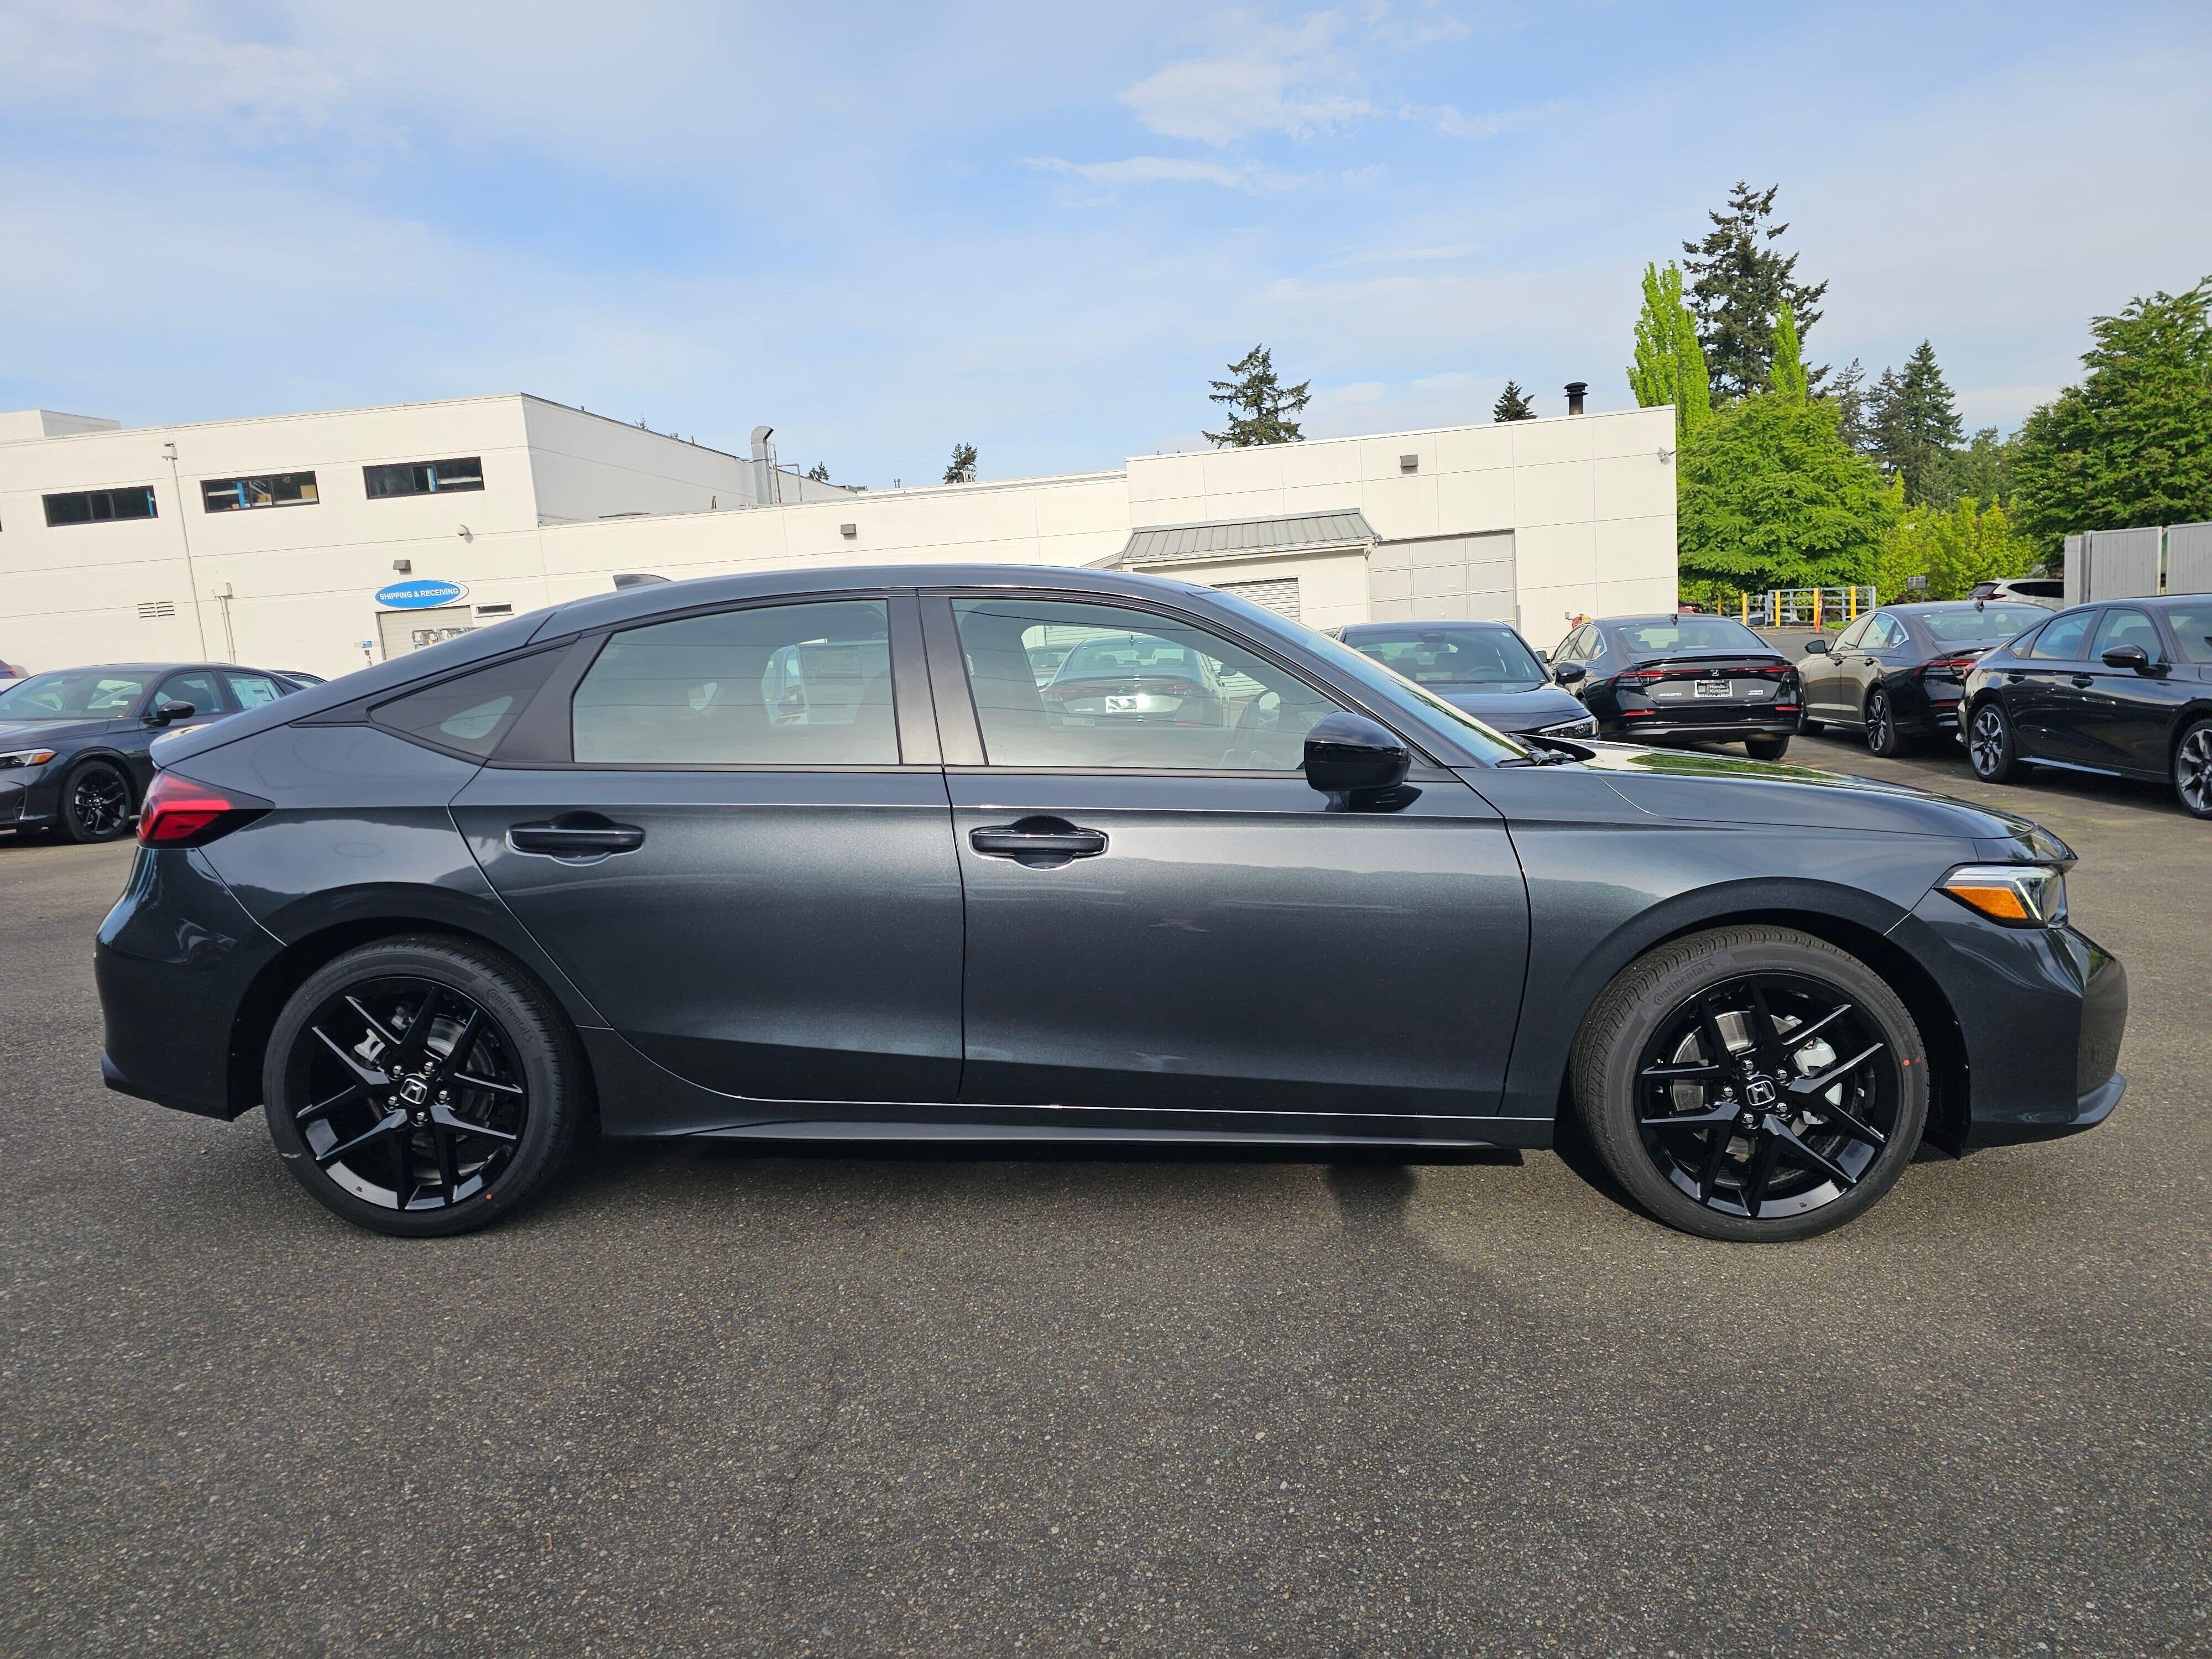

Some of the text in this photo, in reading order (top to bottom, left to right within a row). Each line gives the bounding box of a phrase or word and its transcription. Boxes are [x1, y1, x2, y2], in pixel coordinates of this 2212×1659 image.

[379, 591, 413, 601] SHIPPING
[420, 588, 459, 597] RECEIVING
[1653, 964, 1707, 1005] Continental
[487, 988, 530, 1035] Continental
